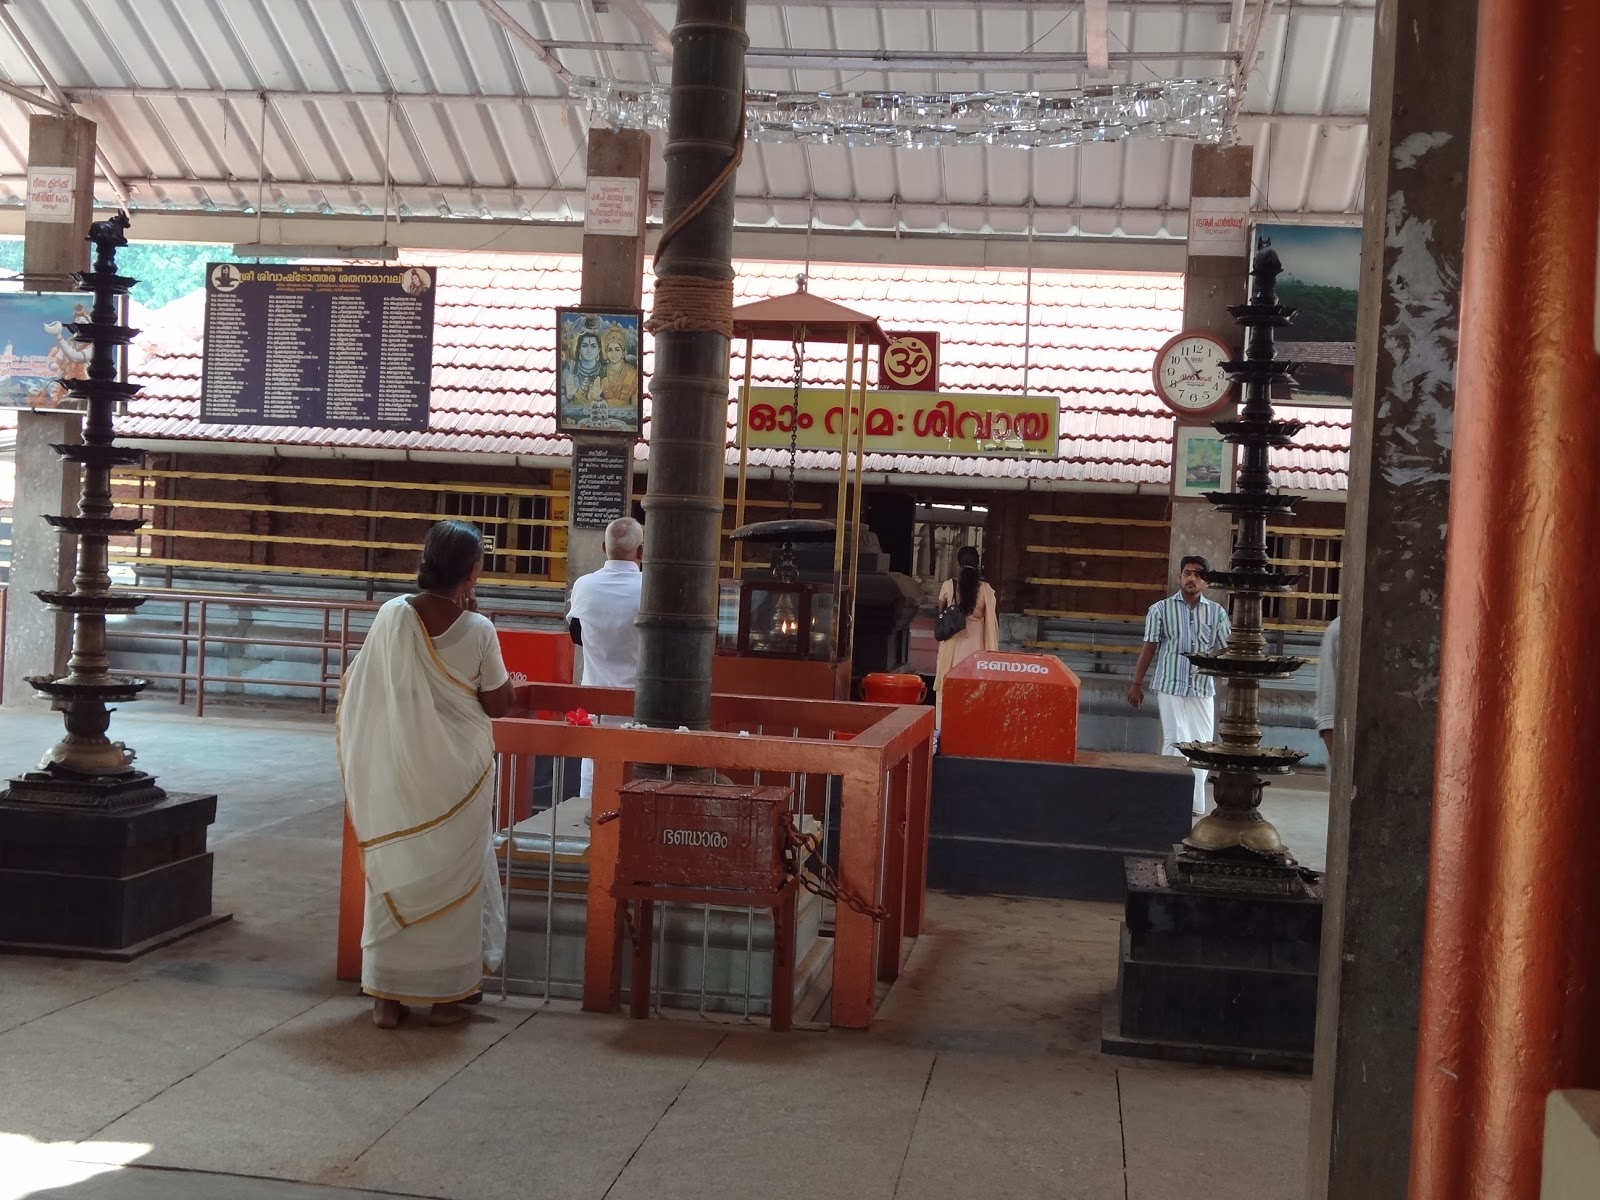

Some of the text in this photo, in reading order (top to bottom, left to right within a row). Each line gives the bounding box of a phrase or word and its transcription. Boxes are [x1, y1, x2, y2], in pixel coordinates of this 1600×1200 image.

[239, 270, 254, 283] ശ്രീ
[339, 272, 405, 284] ശതനാമാവലി
[1181, 347, 1189, 356] 11
[1192, 344, 1204, 353] 12
[1208, 348, 1212, 357] 1
[1171, 355, 1180, 365] 10
[1167, 367, 1175, 376] 9
[1217, 370, 1225, 379] 3
[1170, 379, 1177, 388] 8
[1212, 382, 1219, 391] 4
[1178, 389, 1185, 398] 7
[1189, 393, 1198, 402] 6
[1201, 390, 1210, 400] 5
[749, 403, 813, 432] ഓം
[913, 400, 1049, 441] ശിവായ
[976, 660, 1049, 674] ഭണ്ഡാരം
[663, 829, 728, 849] ഭണ്ഡാരം
